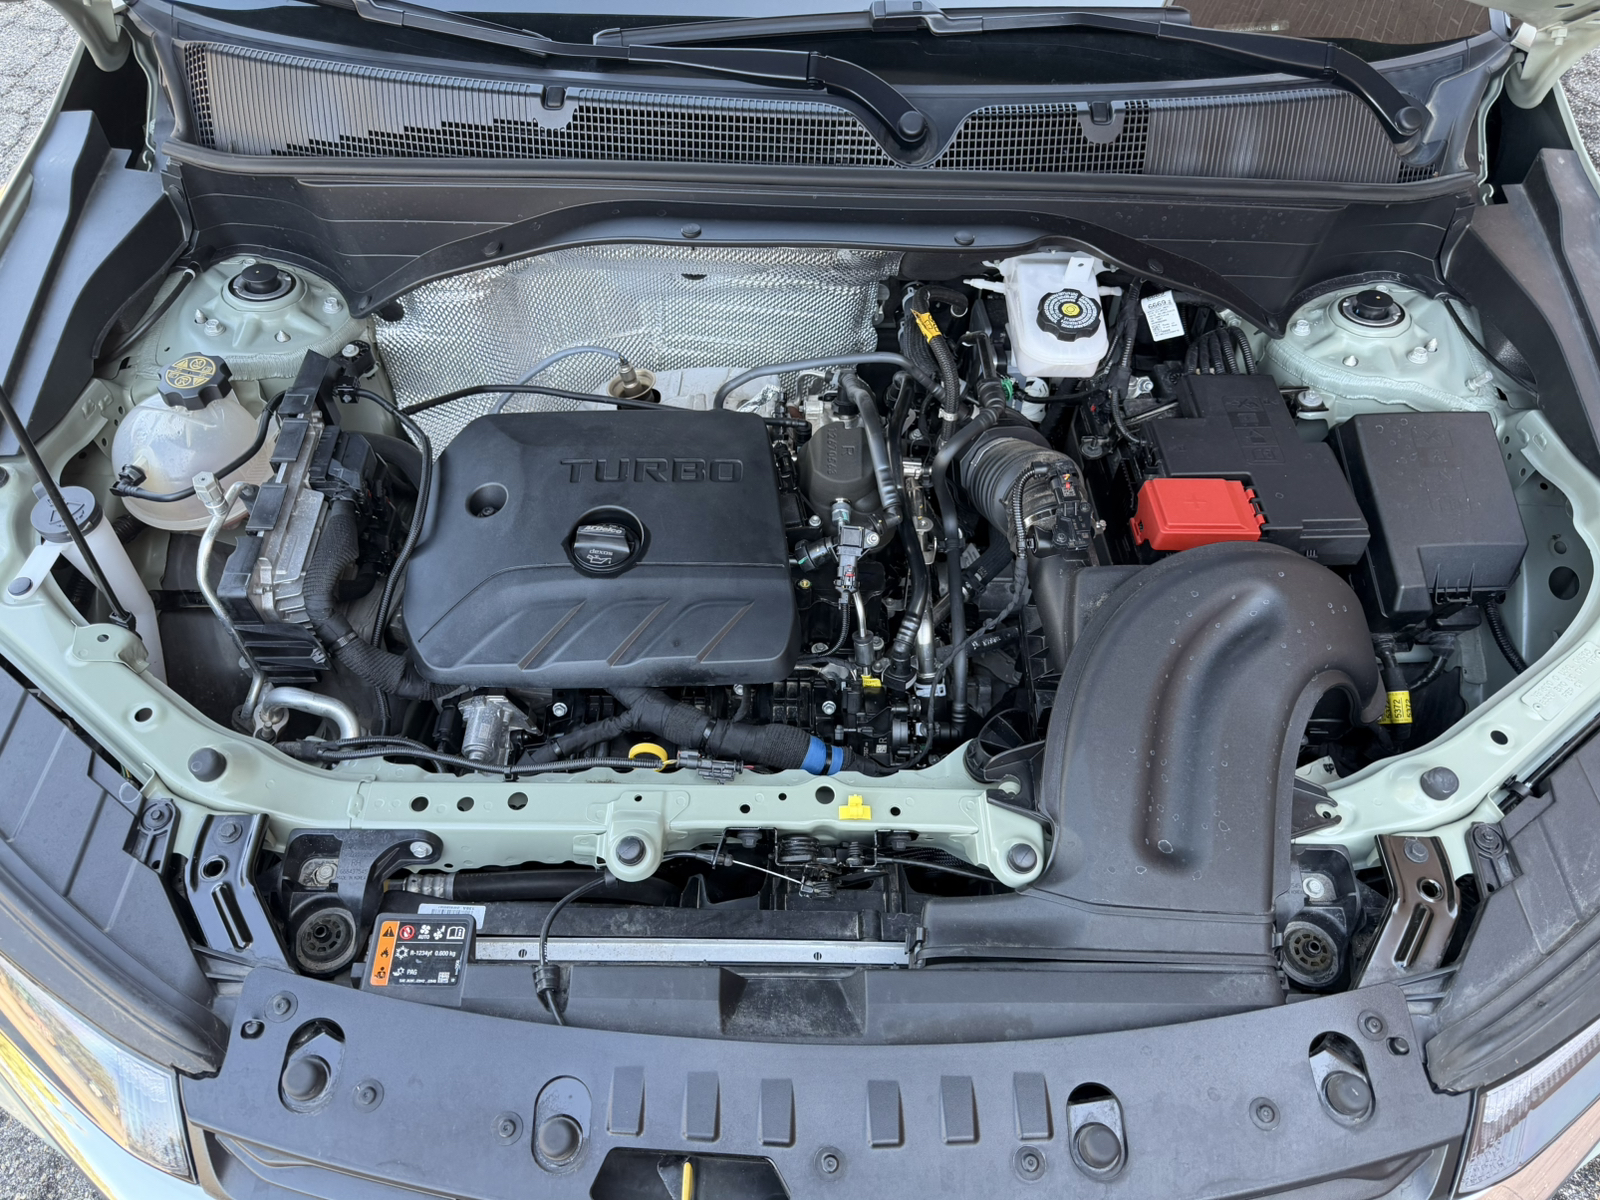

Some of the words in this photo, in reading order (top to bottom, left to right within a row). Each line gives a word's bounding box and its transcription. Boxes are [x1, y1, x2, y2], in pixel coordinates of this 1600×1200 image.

[841, 445, 856, 456] R
[560, 457, 744, 483] TURBO
[583, 525, 623, 534] ACDelco
[1392, 698, 1402, 719] 5372
[409, 950, 433, 958] R-1234yf
[449, 950, 457, 958] kg
[406, 968, 418, 976] PAG
